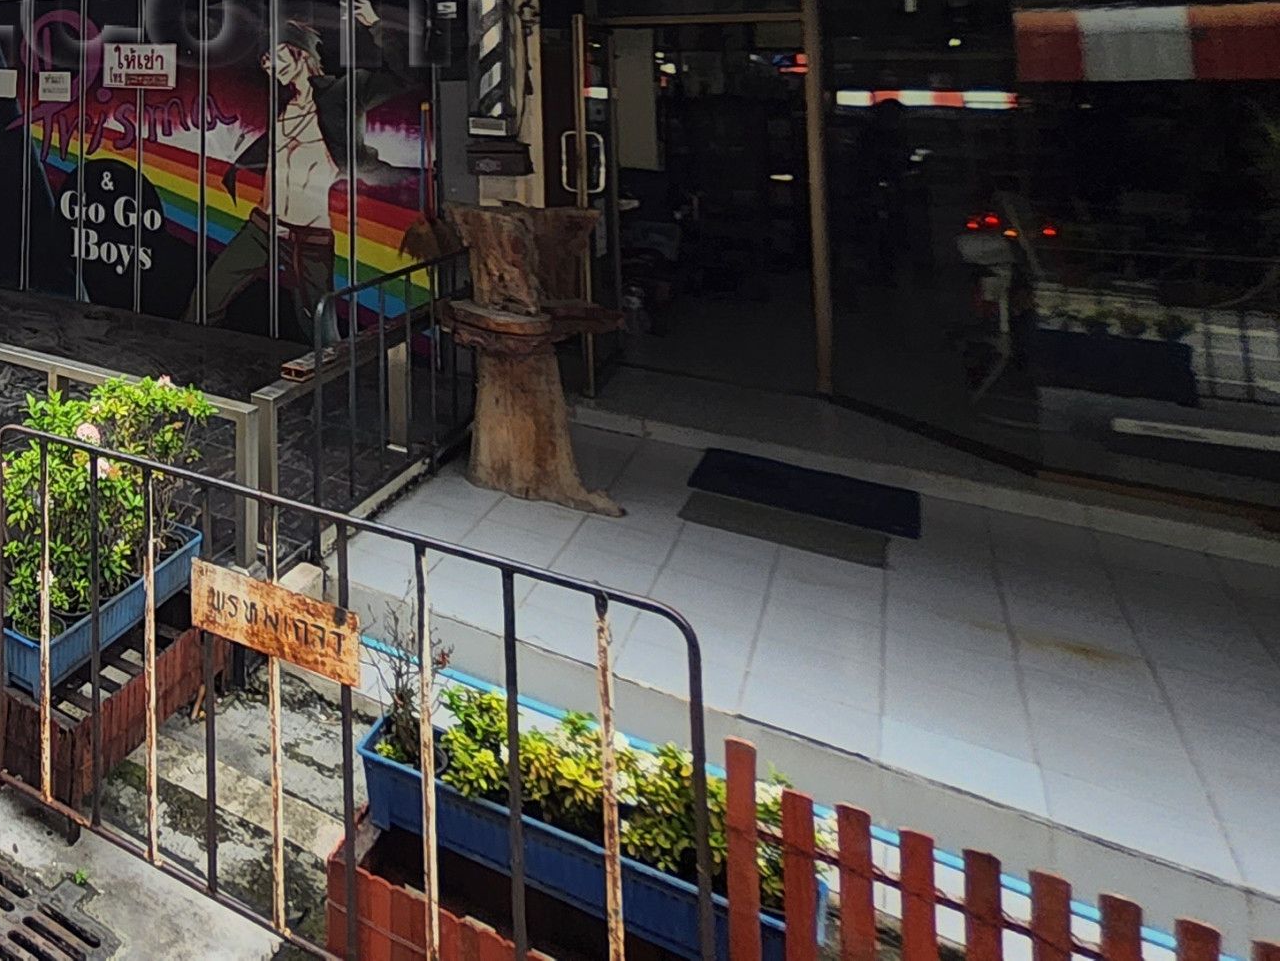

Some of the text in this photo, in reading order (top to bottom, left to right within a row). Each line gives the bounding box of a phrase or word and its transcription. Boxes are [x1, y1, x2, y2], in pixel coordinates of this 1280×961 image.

[114, 44, 164, 71] ให้เช่า
[101, 171, 114, 190] &
[60, 190, 162, 230] Go Go
[70, 226, 152, 274] Boys
